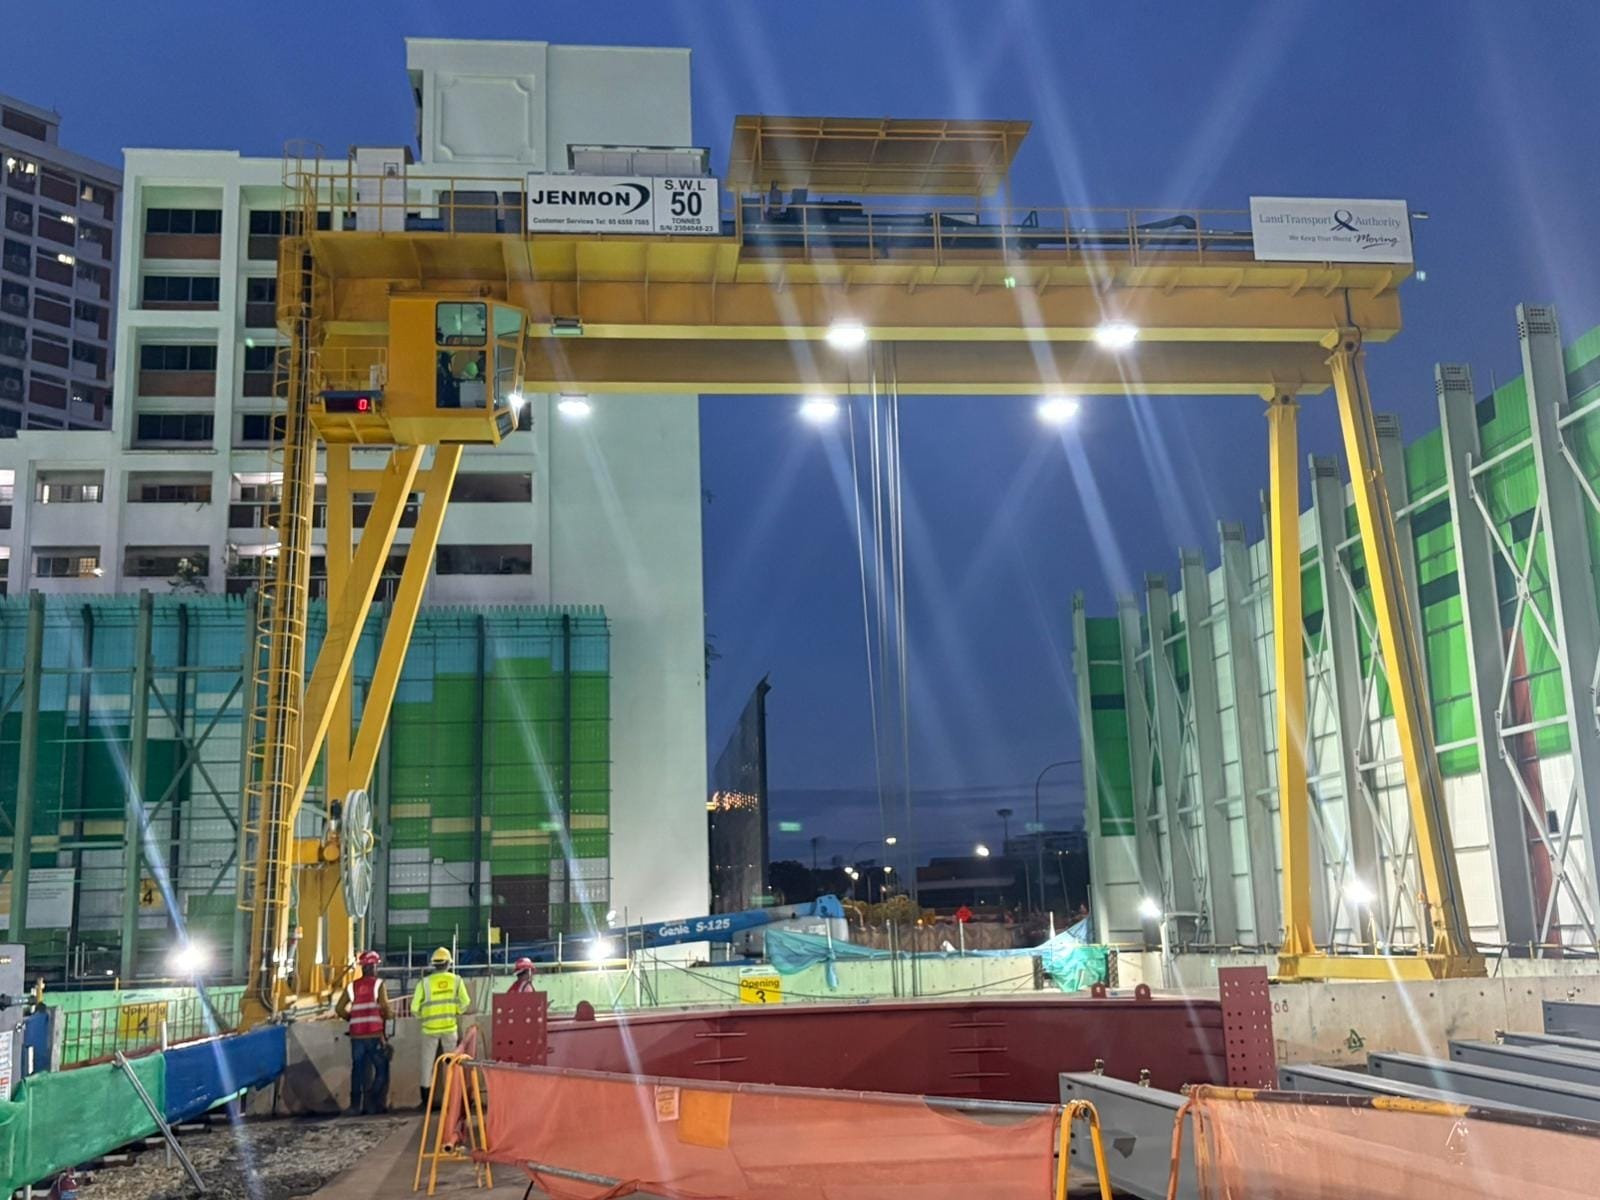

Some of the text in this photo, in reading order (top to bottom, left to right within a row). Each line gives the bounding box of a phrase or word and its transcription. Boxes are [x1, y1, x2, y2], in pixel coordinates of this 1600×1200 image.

[664, 179, 706, 191] S.W.L
[532, 190, 630, 206] JENMON
[671, 191, 702, 216] 50
[566, 217, 594, 225] Services
[672, 217, 701, 225] TONNES
[1259, 213, 1401, 229] Land Transport Authority
[1354, 233, 1398, 247] Moving
[143, 889, 154, 905] 4
[659, 924, 690, 937] Genie
[696, 918, 730, 932] S-125
[741, 979, 780, 989] Opening
[756, 990, 766, 1003] 3
[138, 1016, 150, 1034] 4
